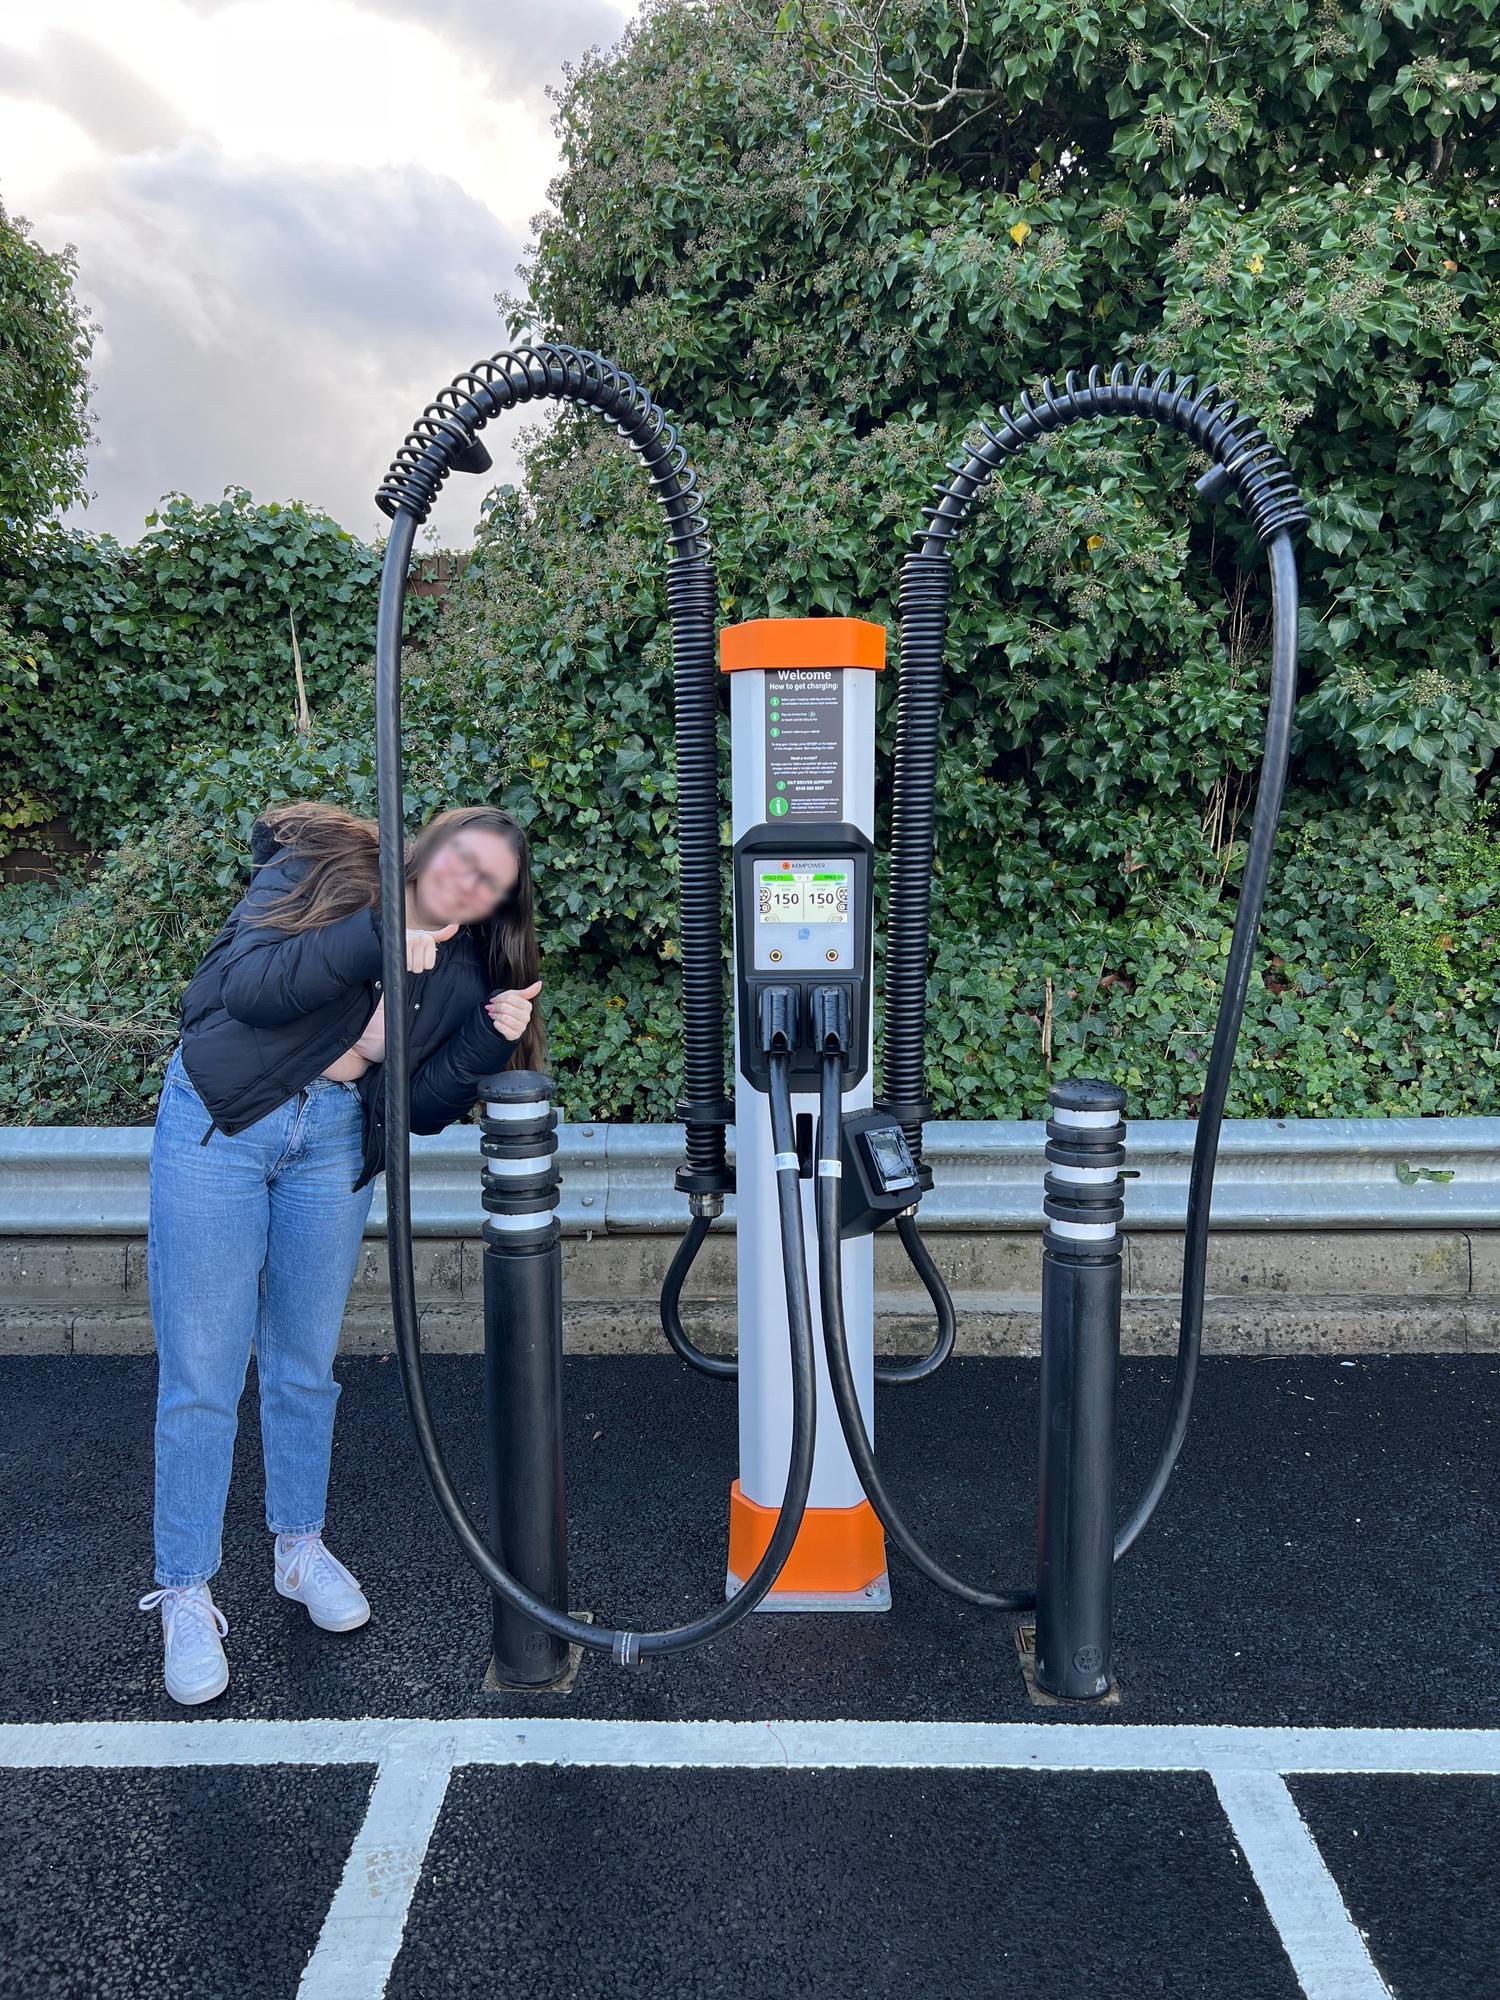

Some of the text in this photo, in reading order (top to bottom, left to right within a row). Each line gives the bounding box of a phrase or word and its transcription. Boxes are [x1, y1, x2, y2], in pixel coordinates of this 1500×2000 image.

[777, 669, 832, 681] Welcome
[794, 683, 806, 691] get
[774, 893, 799, 905] 150
[808, 893, 834, 904] 150
